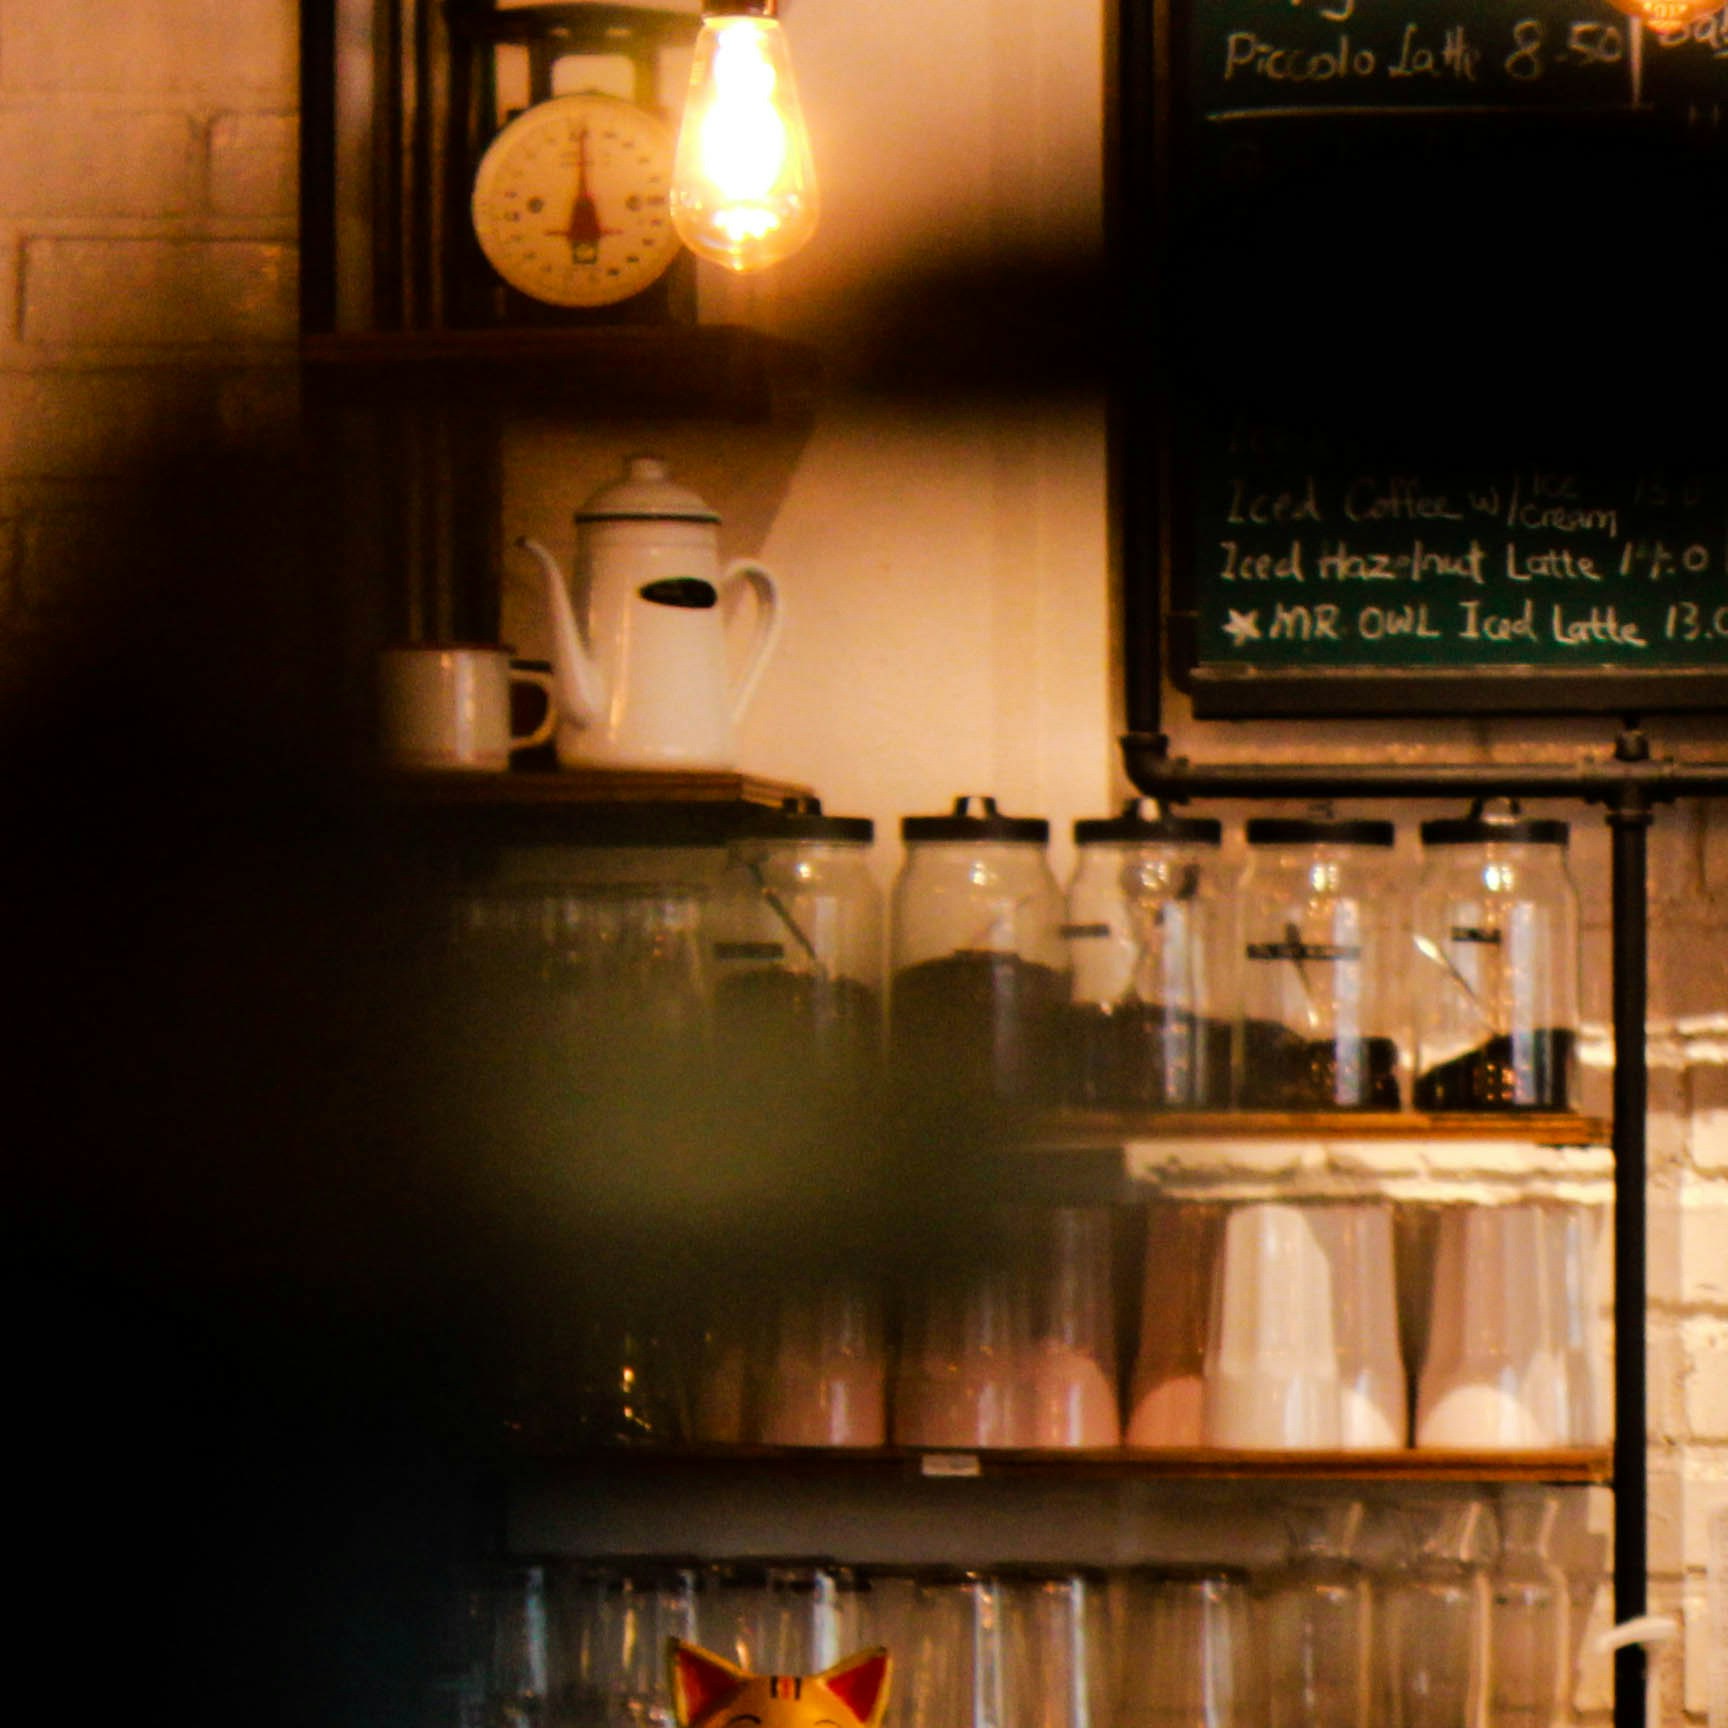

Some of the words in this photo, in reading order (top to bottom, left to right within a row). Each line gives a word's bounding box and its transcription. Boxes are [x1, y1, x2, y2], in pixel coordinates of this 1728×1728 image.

[1224, 30, 1376, 81] Piccolo
[1388, 22, 1482, 82] Latte
[1226, 475, 1324, 525] Iced
[1344, 475, 1464, 523] Coffee
[1520, 502, 1620, 539] cream
[1218, 538, 1306, 583] Iced
[1505, 539, 1604, 582] Latte
[1269, 601, 1342, 642] MR
[1358, 602, 1442, 640] OWL
[1458, 598, 1540, 643] Iced
[1551, 604, 1648, 648] Latte
